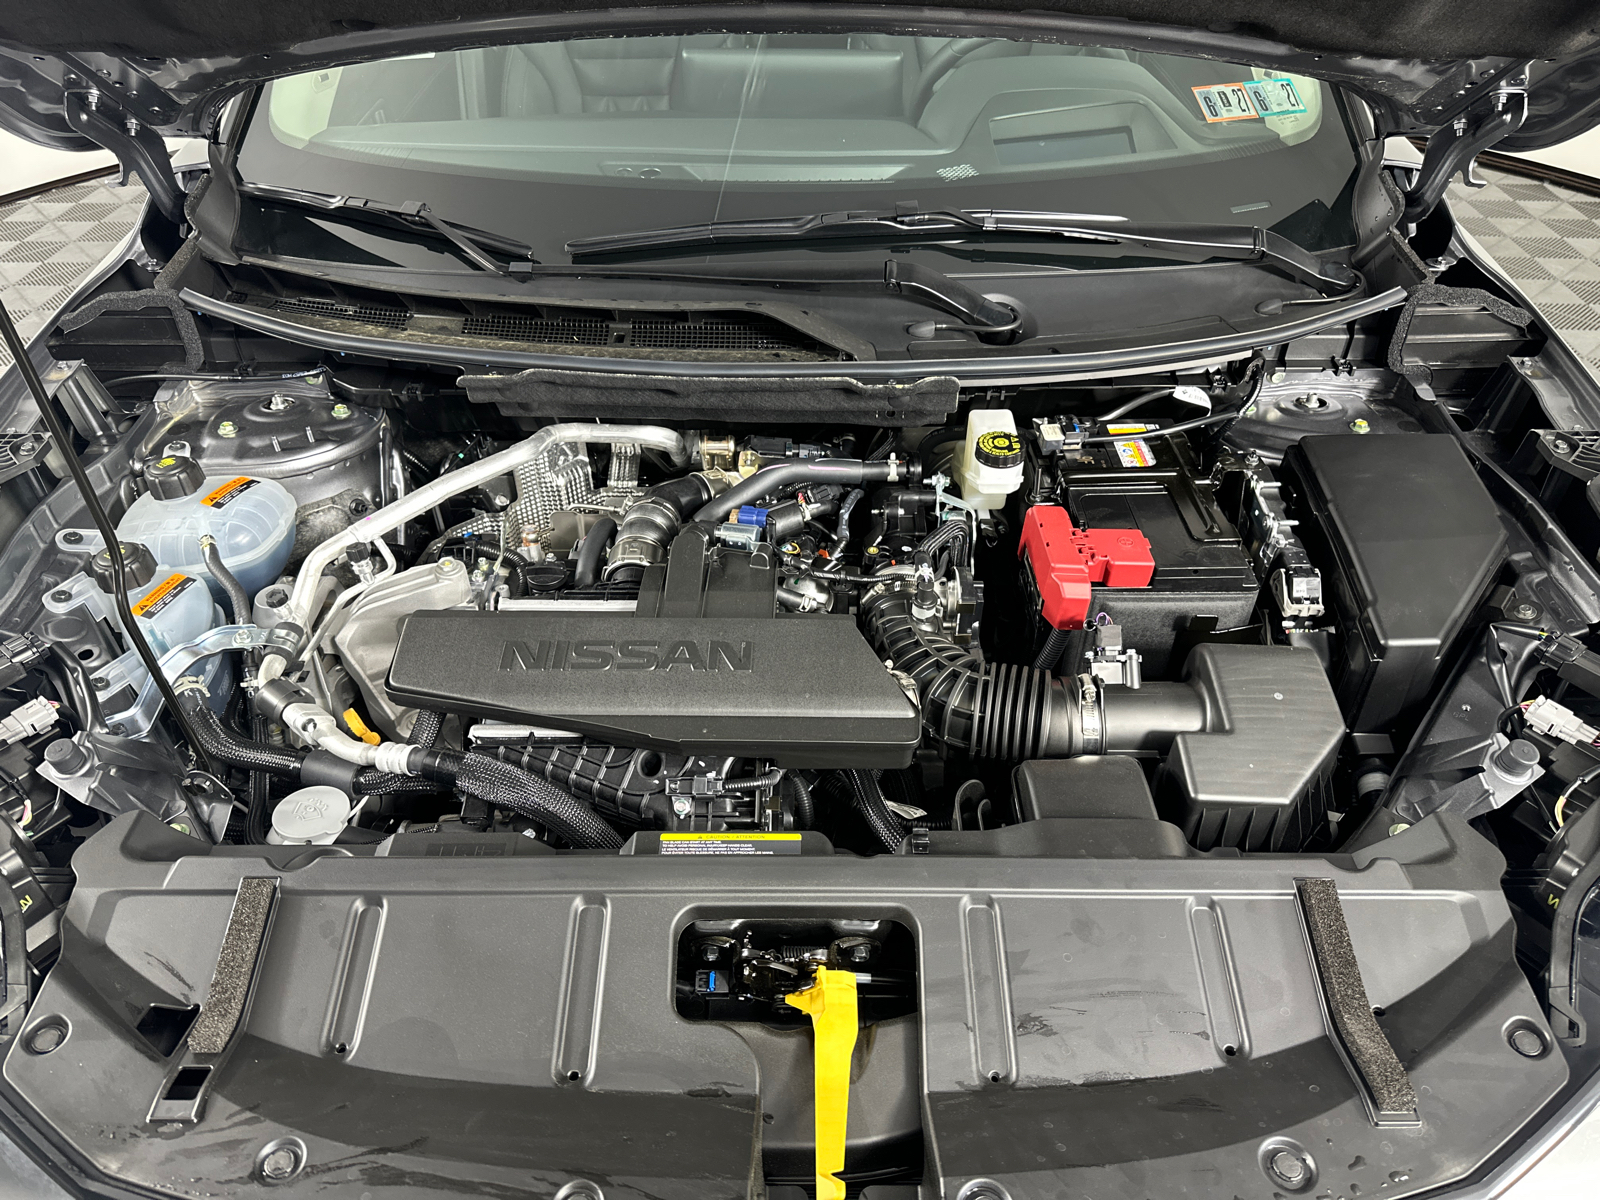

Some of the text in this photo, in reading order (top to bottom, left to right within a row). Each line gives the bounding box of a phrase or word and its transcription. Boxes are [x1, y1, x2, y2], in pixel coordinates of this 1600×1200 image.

[1203, 96, 1218, 117] 6
[1231, 88, 1251, 114] 27
[1253, 90, 1269, 112] 6
[1280, 83, 1300, 108] 27
[498, 640, 754, 672] NISSAN
